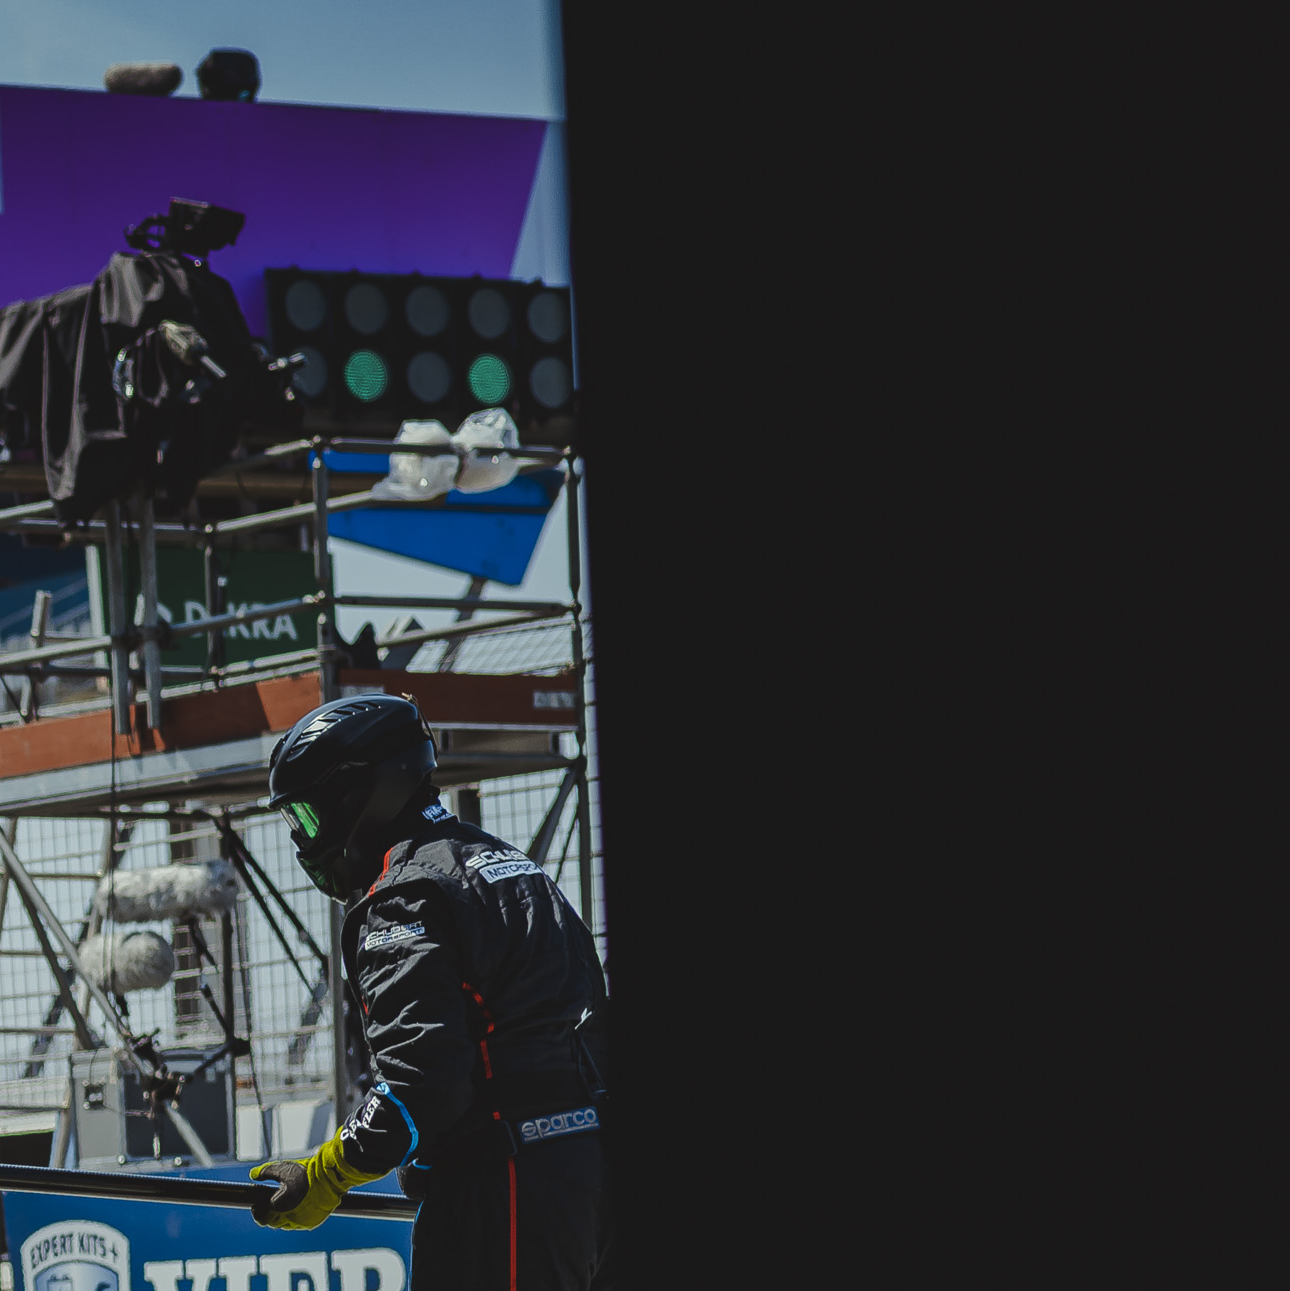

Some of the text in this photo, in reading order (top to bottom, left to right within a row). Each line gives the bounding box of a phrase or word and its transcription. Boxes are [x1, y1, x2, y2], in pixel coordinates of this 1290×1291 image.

[183, 601, 298, 641] DKRA
[521, 1108, 597, 1138] sparco
[29, 1232, 74, 1269] EXPERT
